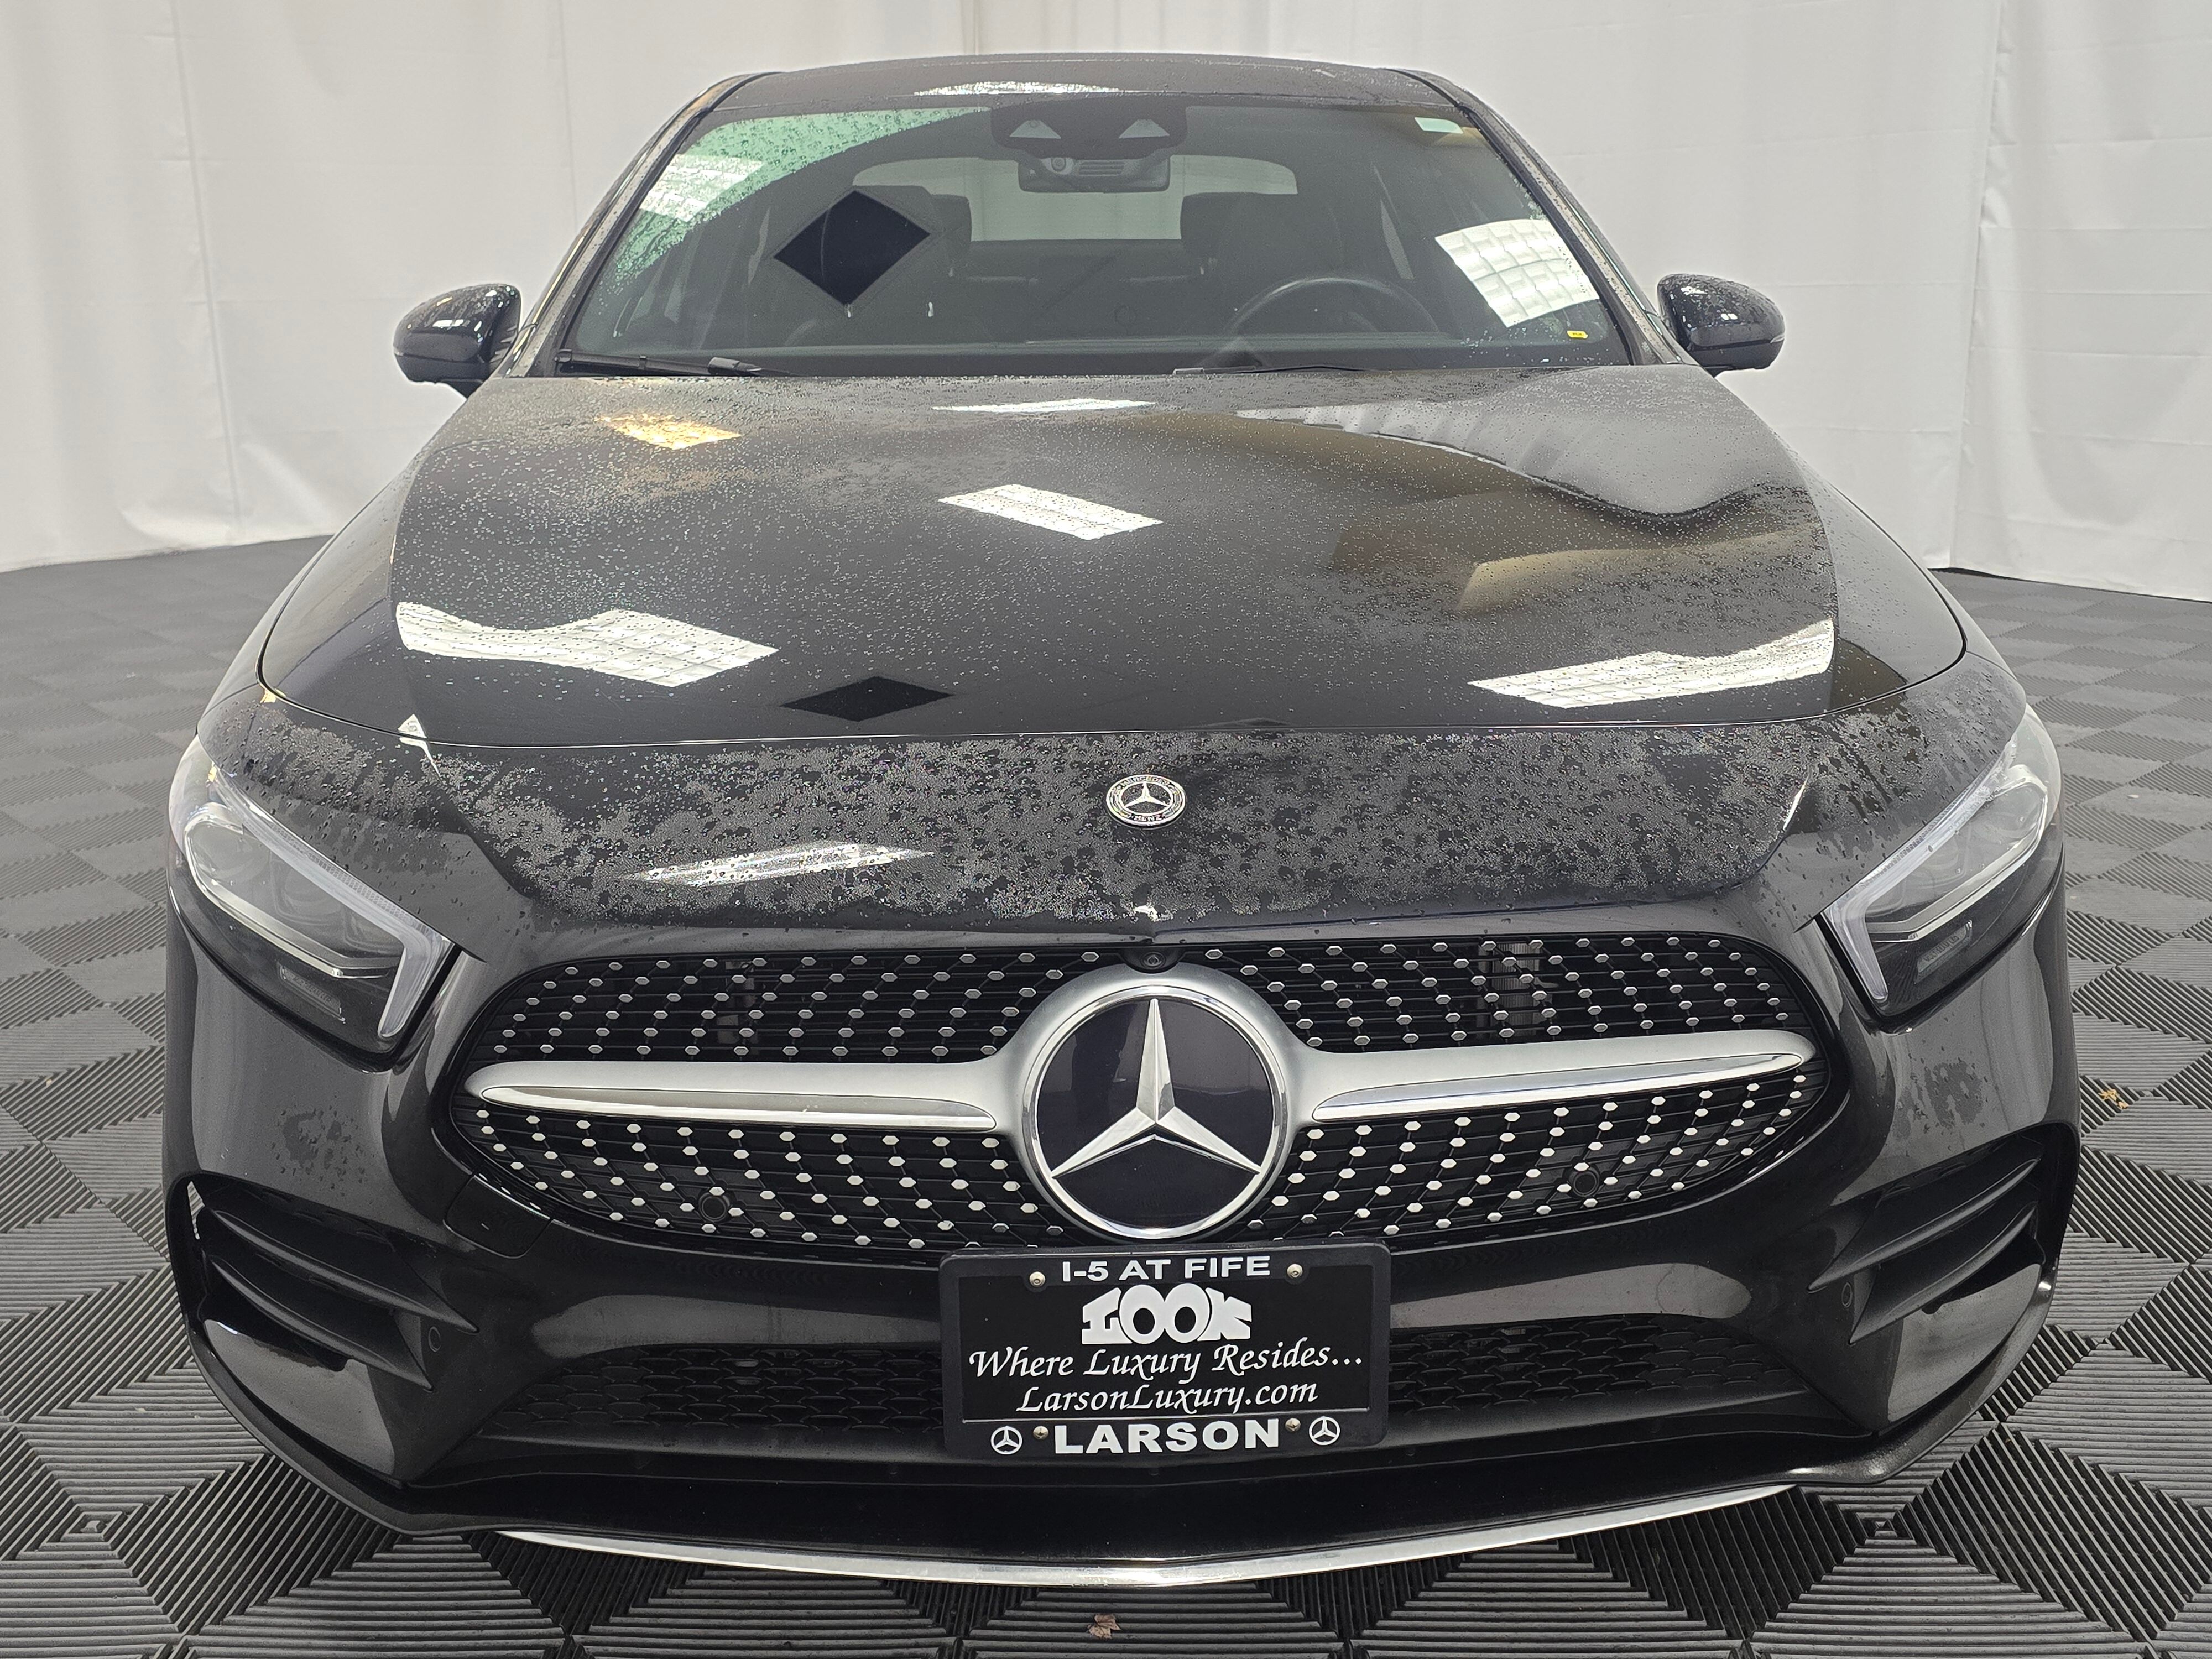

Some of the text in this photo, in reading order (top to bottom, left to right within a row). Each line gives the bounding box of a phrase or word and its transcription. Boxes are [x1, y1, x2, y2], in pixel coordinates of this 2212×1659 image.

[1134, 814, 1162, 822] BENZ
[1063, 1256, 1270, 1282] I-5 AT FIFE
[1082, 1283, 1252, 1345] LOOK
[969, 1337, 1362, 1384] Where Luxury Resides...
[1016, 1384, 1318, 1414] LarsonLuxury.com
[1055, 1418, 1279, 1454] LARSON
